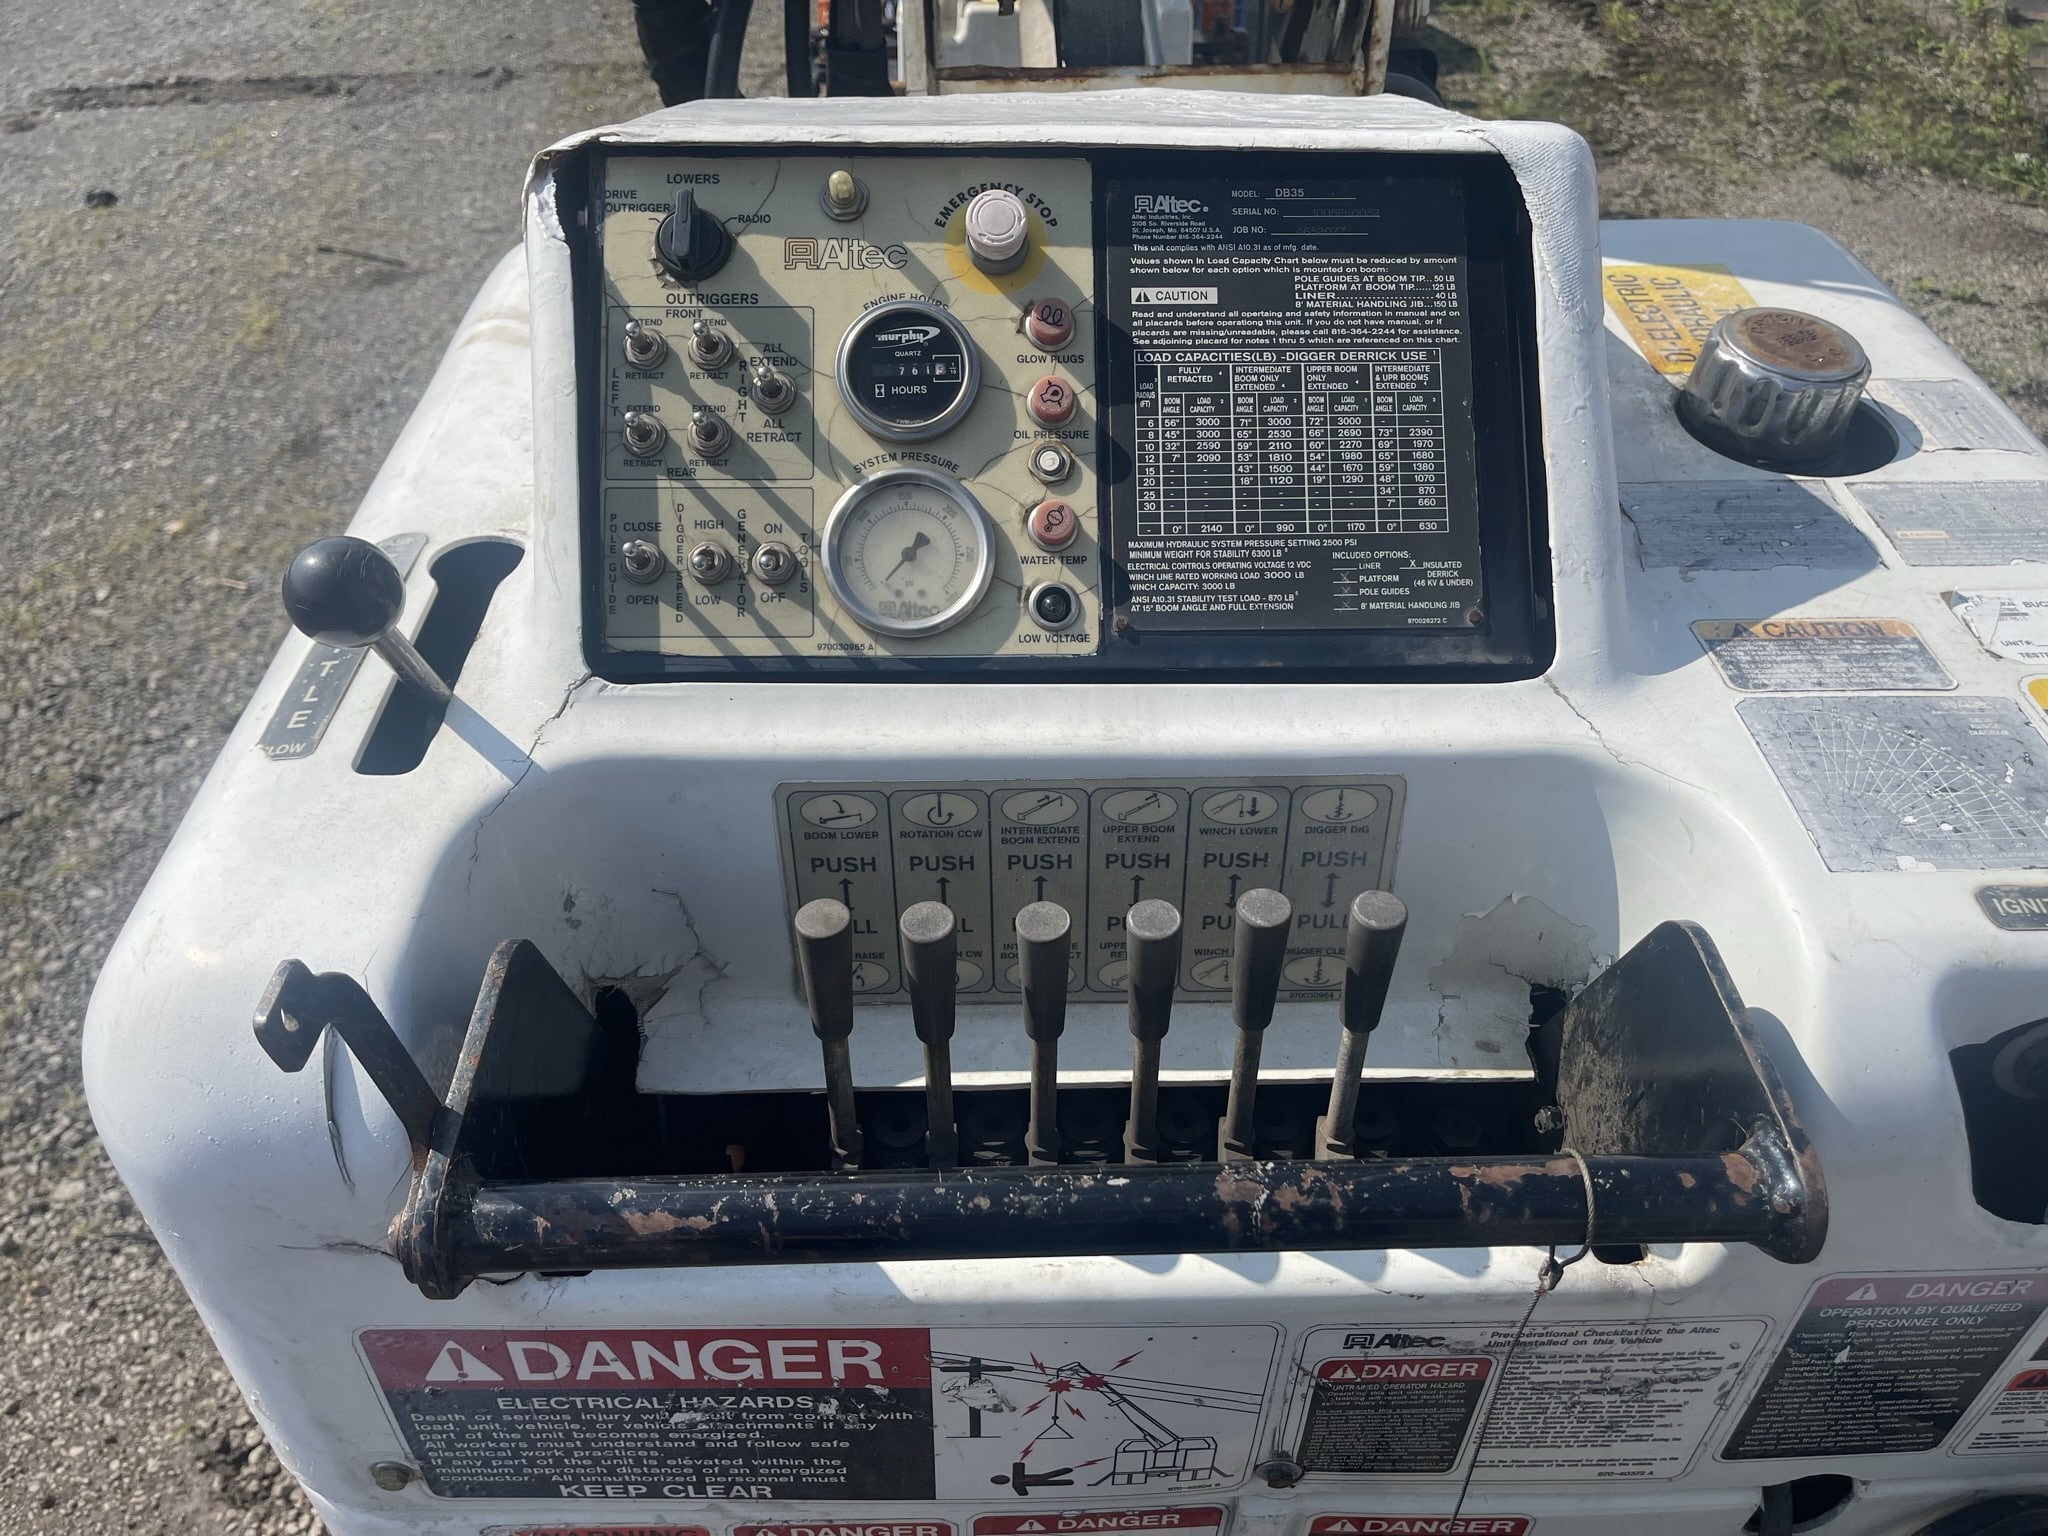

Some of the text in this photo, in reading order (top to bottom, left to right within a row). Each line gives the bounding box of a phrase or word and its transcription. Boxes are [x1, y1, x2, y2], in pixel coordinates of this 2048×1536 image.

[667, 173, 720, 184] LOWERS
[605, 190, 637, 200] DRIVE
[1231, 188, 1305, 198] MODEL: DB35
[605, 203, 671, 213] OUTRIGGER
[1153, 195, 1202, 213] Altec
[1025, 192, 1058, 228] STOP
[1232, 207, 1280, 216] SERIAL NO:
[738, 214, 771, 224] RADIO
[1232, 226, 1267, 234] JOB NO:
[818, 237, 908, 270] Altec
[666, 293, 759, 305] OUTRIGGERS
[1155, 290, 1208, 301] CAUTION
[665, 309, 703, 319] FRONT
[875, 330, 925, 343] murphy
[763, 343, 784, 353] ALL
[1016, 354, 1085, 364] GLOW PLUGS
[1137, 352, 1172, 362] LOAD
[1175, 352, 1277, 363] CAPACITIES(LB)
[1340, 350, 1397, 361] DERRICK
[1401, 350, 1427, 360] USE
[750, 357, 798, 367] EXTEND
[1179, 366, 1202, 375] FULLY
[1235, 365, 1292, 374] INTERMEDIATE
[625, 372, 664, 380] RETRACT
[689, 372, 729, 380] RETRACT
[1167, 375, 1213, 383] RETRACTED
[1260, 374, 1280, 382] ONLY
[611, 368, 620, 417] LEFT
[737, 360, 748, 423] RIGHT
[891, 385, 928, 394] HOURS
[626, 405, 661, 413] EXTEND
[692, 405, 726, 413] EXTEND
[763, 419, 786, 430] ALL
[1013, 430, 1090, 440] OIL PRESSURE
[1267, 430, 1292, 438] 2530
[1408, 428, 1433, 436] 2390
[746, 432, 802, 443] RETRACT
[623, 459, 663, 467] RETRACT
[688, 459, 728, 467] RETRACT
[853, 451, 961, 474] SYSTEM PRESSURE
[667, 468, 697, 477] REAR
[623, 522, 662, 532] CLOSE
[694, 519, 724, 530] HIGH
[764, 523, 783, 534] ON
[1128, 538, 1357, 549] MAXIMUM HYDRAULIC SYSTEM PRESSURE SETTING 2500 PSI
[1020, 555, 1088, 566] WATER TEMP
[1332, 551, 1411, 560] INCLUDED OPTIONS:
[675, 503, 685, 623] DIGGER SPEED
[626, 595, 659, 605] OPEN
[695, 595, 721, 606] LOW
[760, 592, 786, 603] OFF
[1762, 621, 1886, 638] CAUTION
[1018, 634, 1091, 644] LOW VOLTAGE
[868, 643, 874, 651] A
[900, 830, 983, 839] ROTATION CCW
[1000, 826, 1080, 835] INTERMEDIATE
[1103, 825, 1175, 834] UPPER BOOM
[1200, 826, 1278, 836] WINCH LOWER
[1304, 826, 1369, 835] DIGGER DIG
[803, 831, 879, 841] BOOM LOWER
[1000, 836, 1080, 845] BOOM EXTEND
[1117, 835, 1160, 844] EXTEND
[811, 856, 877, 873] PUSH
[909, 855, 975, 872] PUSH
[1007, 854, 1072, 870] PUSH
[1105, 853, 1170, 870] PUSH
[1203, 852, 1269, 868] PUSH
[1301, 851, 1367, 868] PUSH
[855, 952, 885, 960] RAISE
[966, 950, 983, 958] CW
[1194, 948, 1229, 956] WINCH
[1285, 948, 1322, 956] DIGGER
[1905, 1280, 2034, 1299] DANGER
[1819, 1303, 2022, 1318] OPERATION BY QUALIFIED
[1844, 1316, 1987, 1329] PERSONNEL ONLY
[1583, 1328, 1639, 1337] Checklist
[1645, 1328, 1662, 1336] for
[1666, 1327, 1685, 1335] the
[1689, 1326, 1721, 1334] Altec
[1593, 1338, 1614, 1346] this
[1620, 1336, 1663, 1345] Vehicle
[505, 1339, 884, 1381] DANGER
[1361, 1362, 1479, 1379] DANGER
[1383, 1382, 1427, 1390] OPERATOR
[496, 1396, 814, 1410] ELECTRICAL HAZARDS
[425, 1439, 850, 1449] All workers must understand and follow safe
[559, 1484, 773, 1499] KEEP CLEAR
[1057, 1513, 1180, 1530] DANGER
[789, 1526, 939, 1536] DANGER
[1362, 1520, 1515, 1535] DANGER
